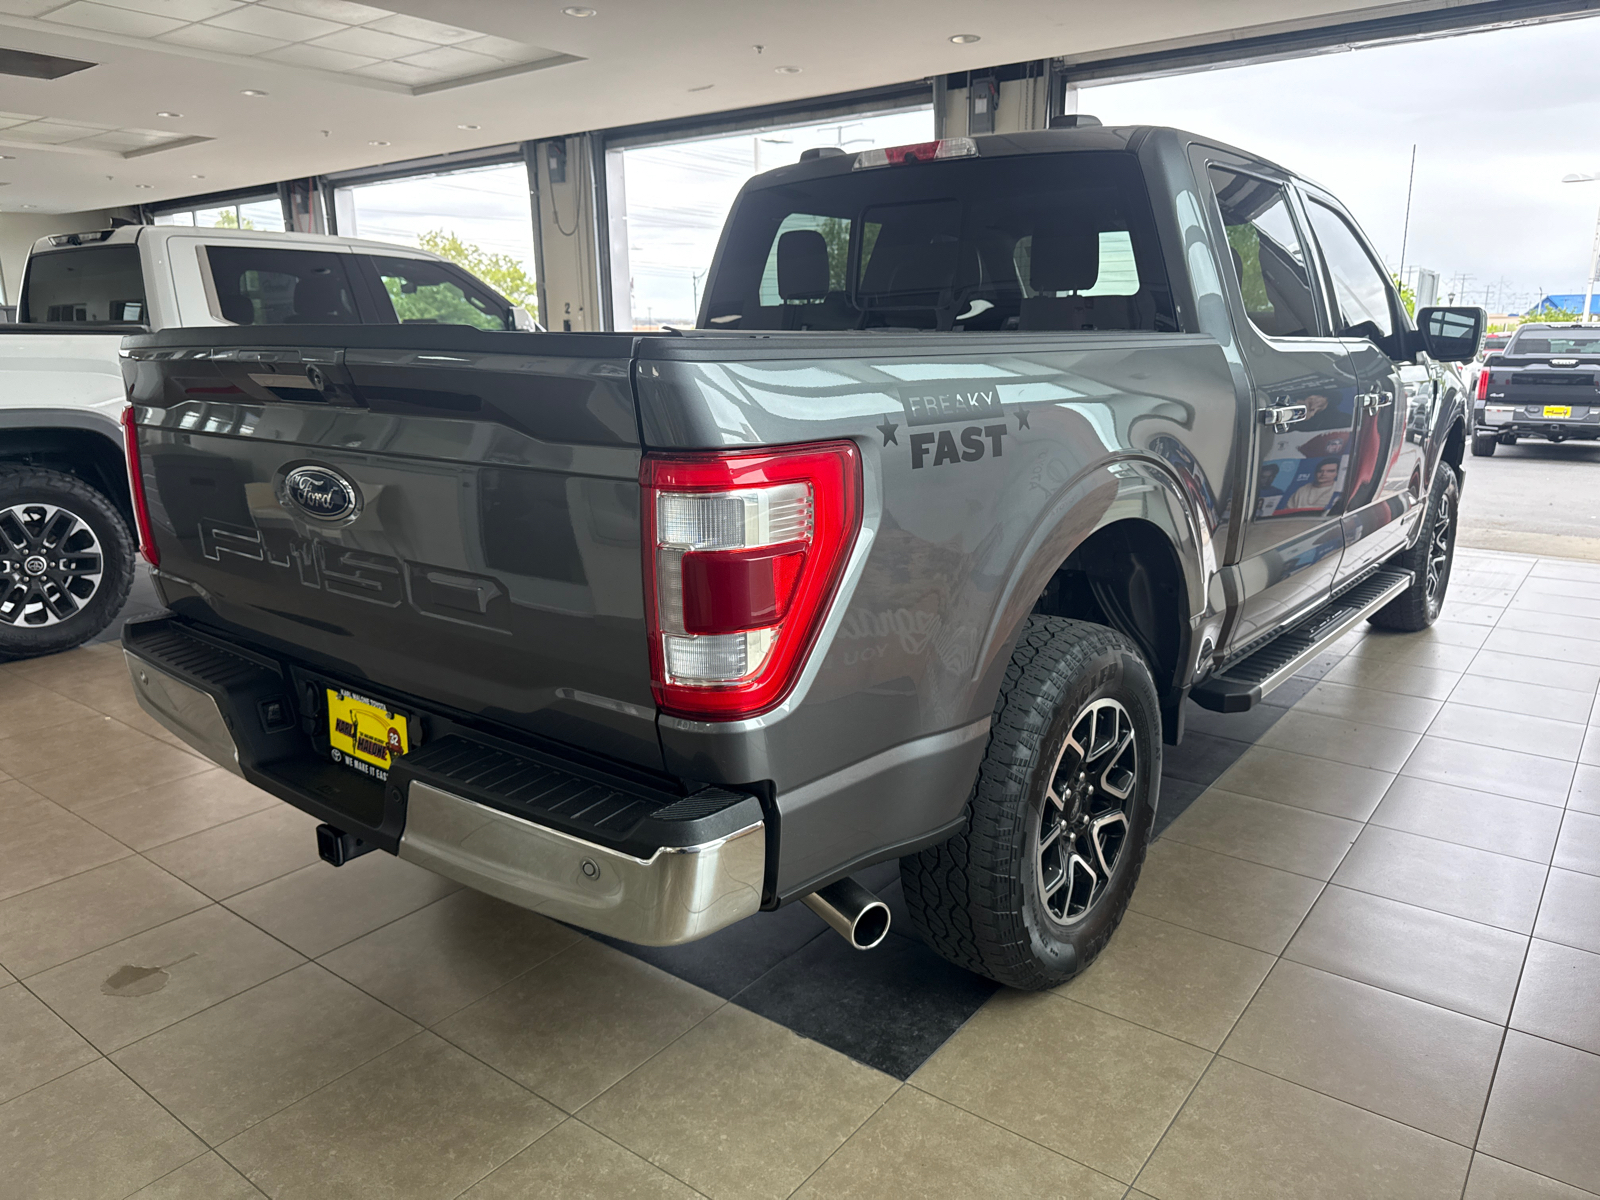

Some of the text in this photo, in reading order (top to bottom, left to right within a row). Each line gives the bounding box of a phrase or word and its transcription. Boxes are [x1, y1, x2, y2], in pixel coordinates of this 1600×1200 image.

[565, 303, 571, 315] 2
[908, 390, 994, 418] FREAKY
[909, 424, 1008, 470] FAST
[297, 476, 339, 510] Ford
[197, 517, 514, 636] F-150
[336, 718, 354, 738] KARL
[389, 732, 399, 746] 32
[357, 738, 388, 761] MALONE
[353, 760, 369, 773] MAKE
[369, 766, 376, 776] IT
[375, 769, 389, 782] EAS
